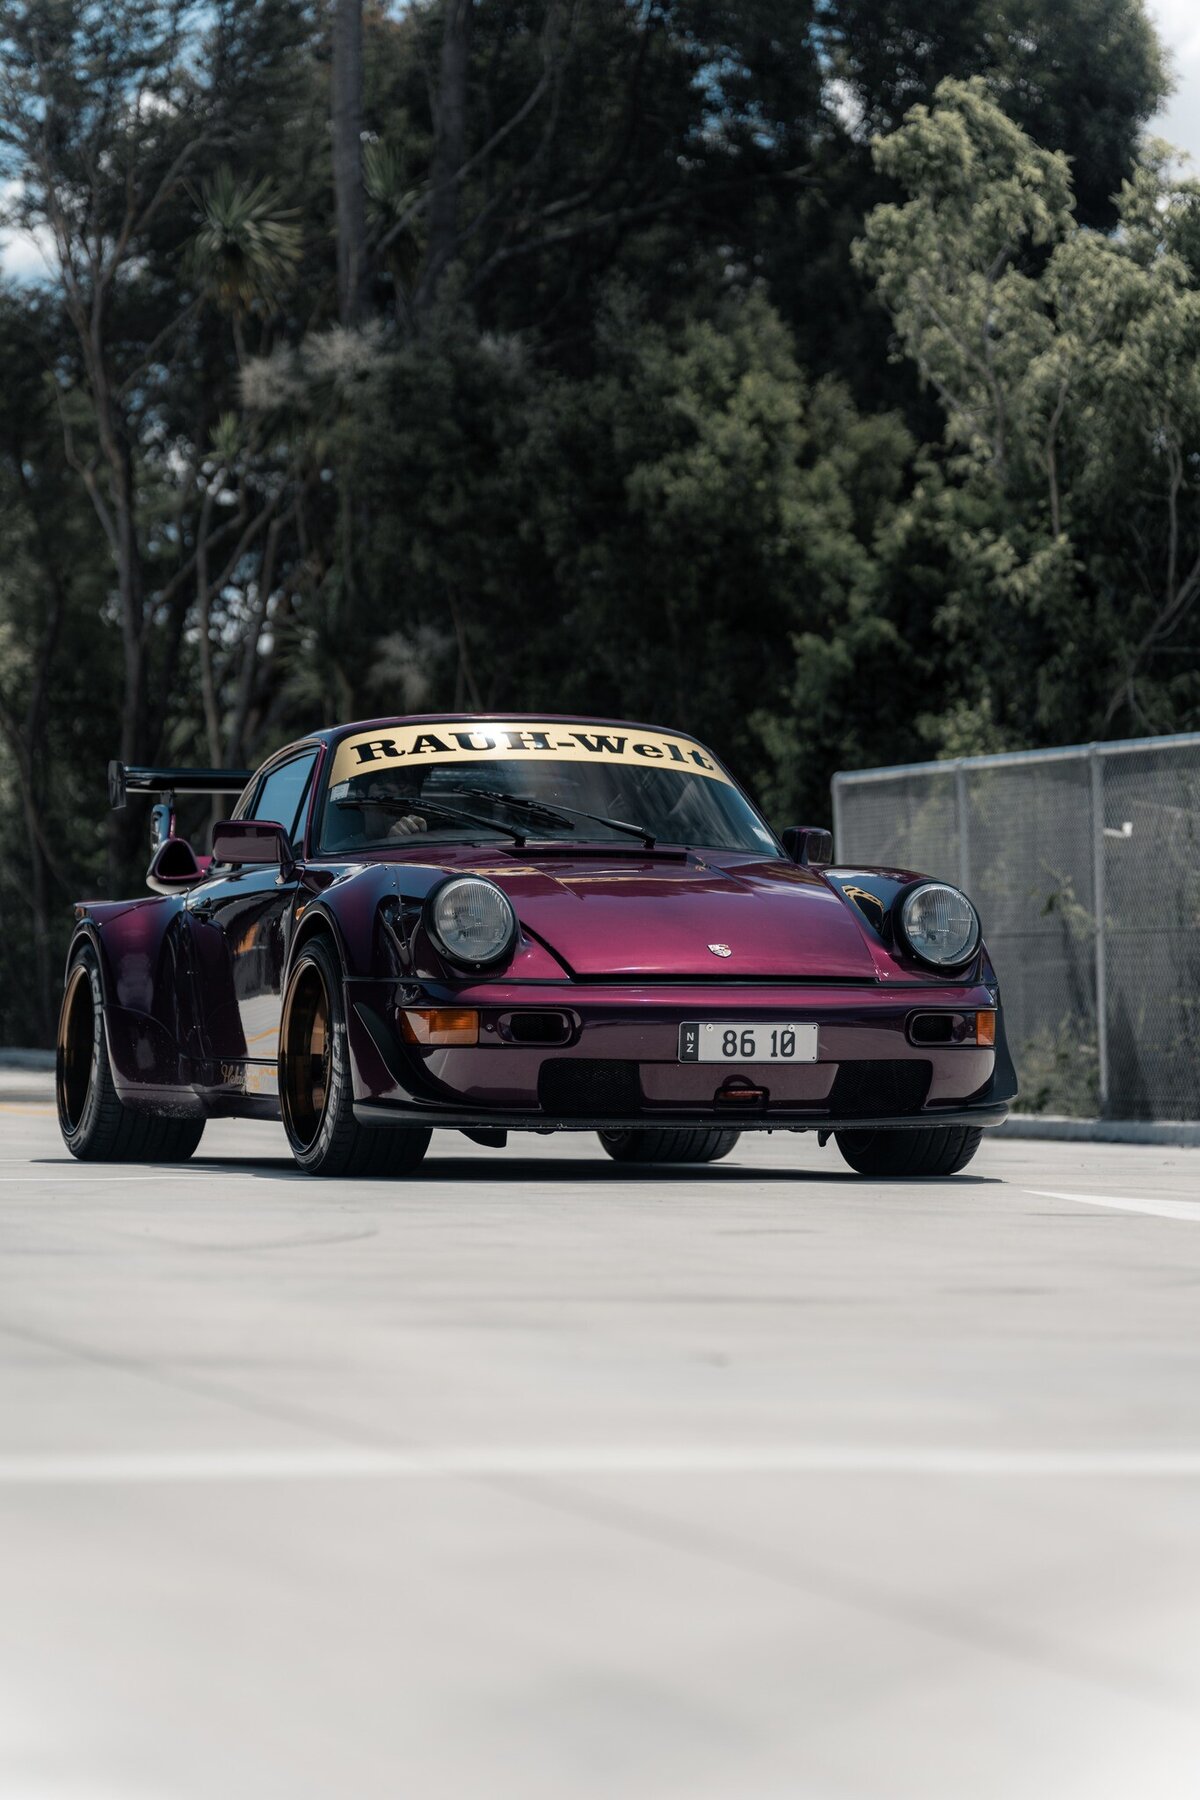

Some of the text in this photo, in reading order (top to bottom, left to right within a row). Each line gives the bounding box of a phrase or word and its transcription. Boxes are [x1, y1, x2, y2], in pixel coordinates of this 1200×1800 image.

[350, 732, 714, 771] RAUH-Welt
[722, 1030, 796, 1057] 86 10
